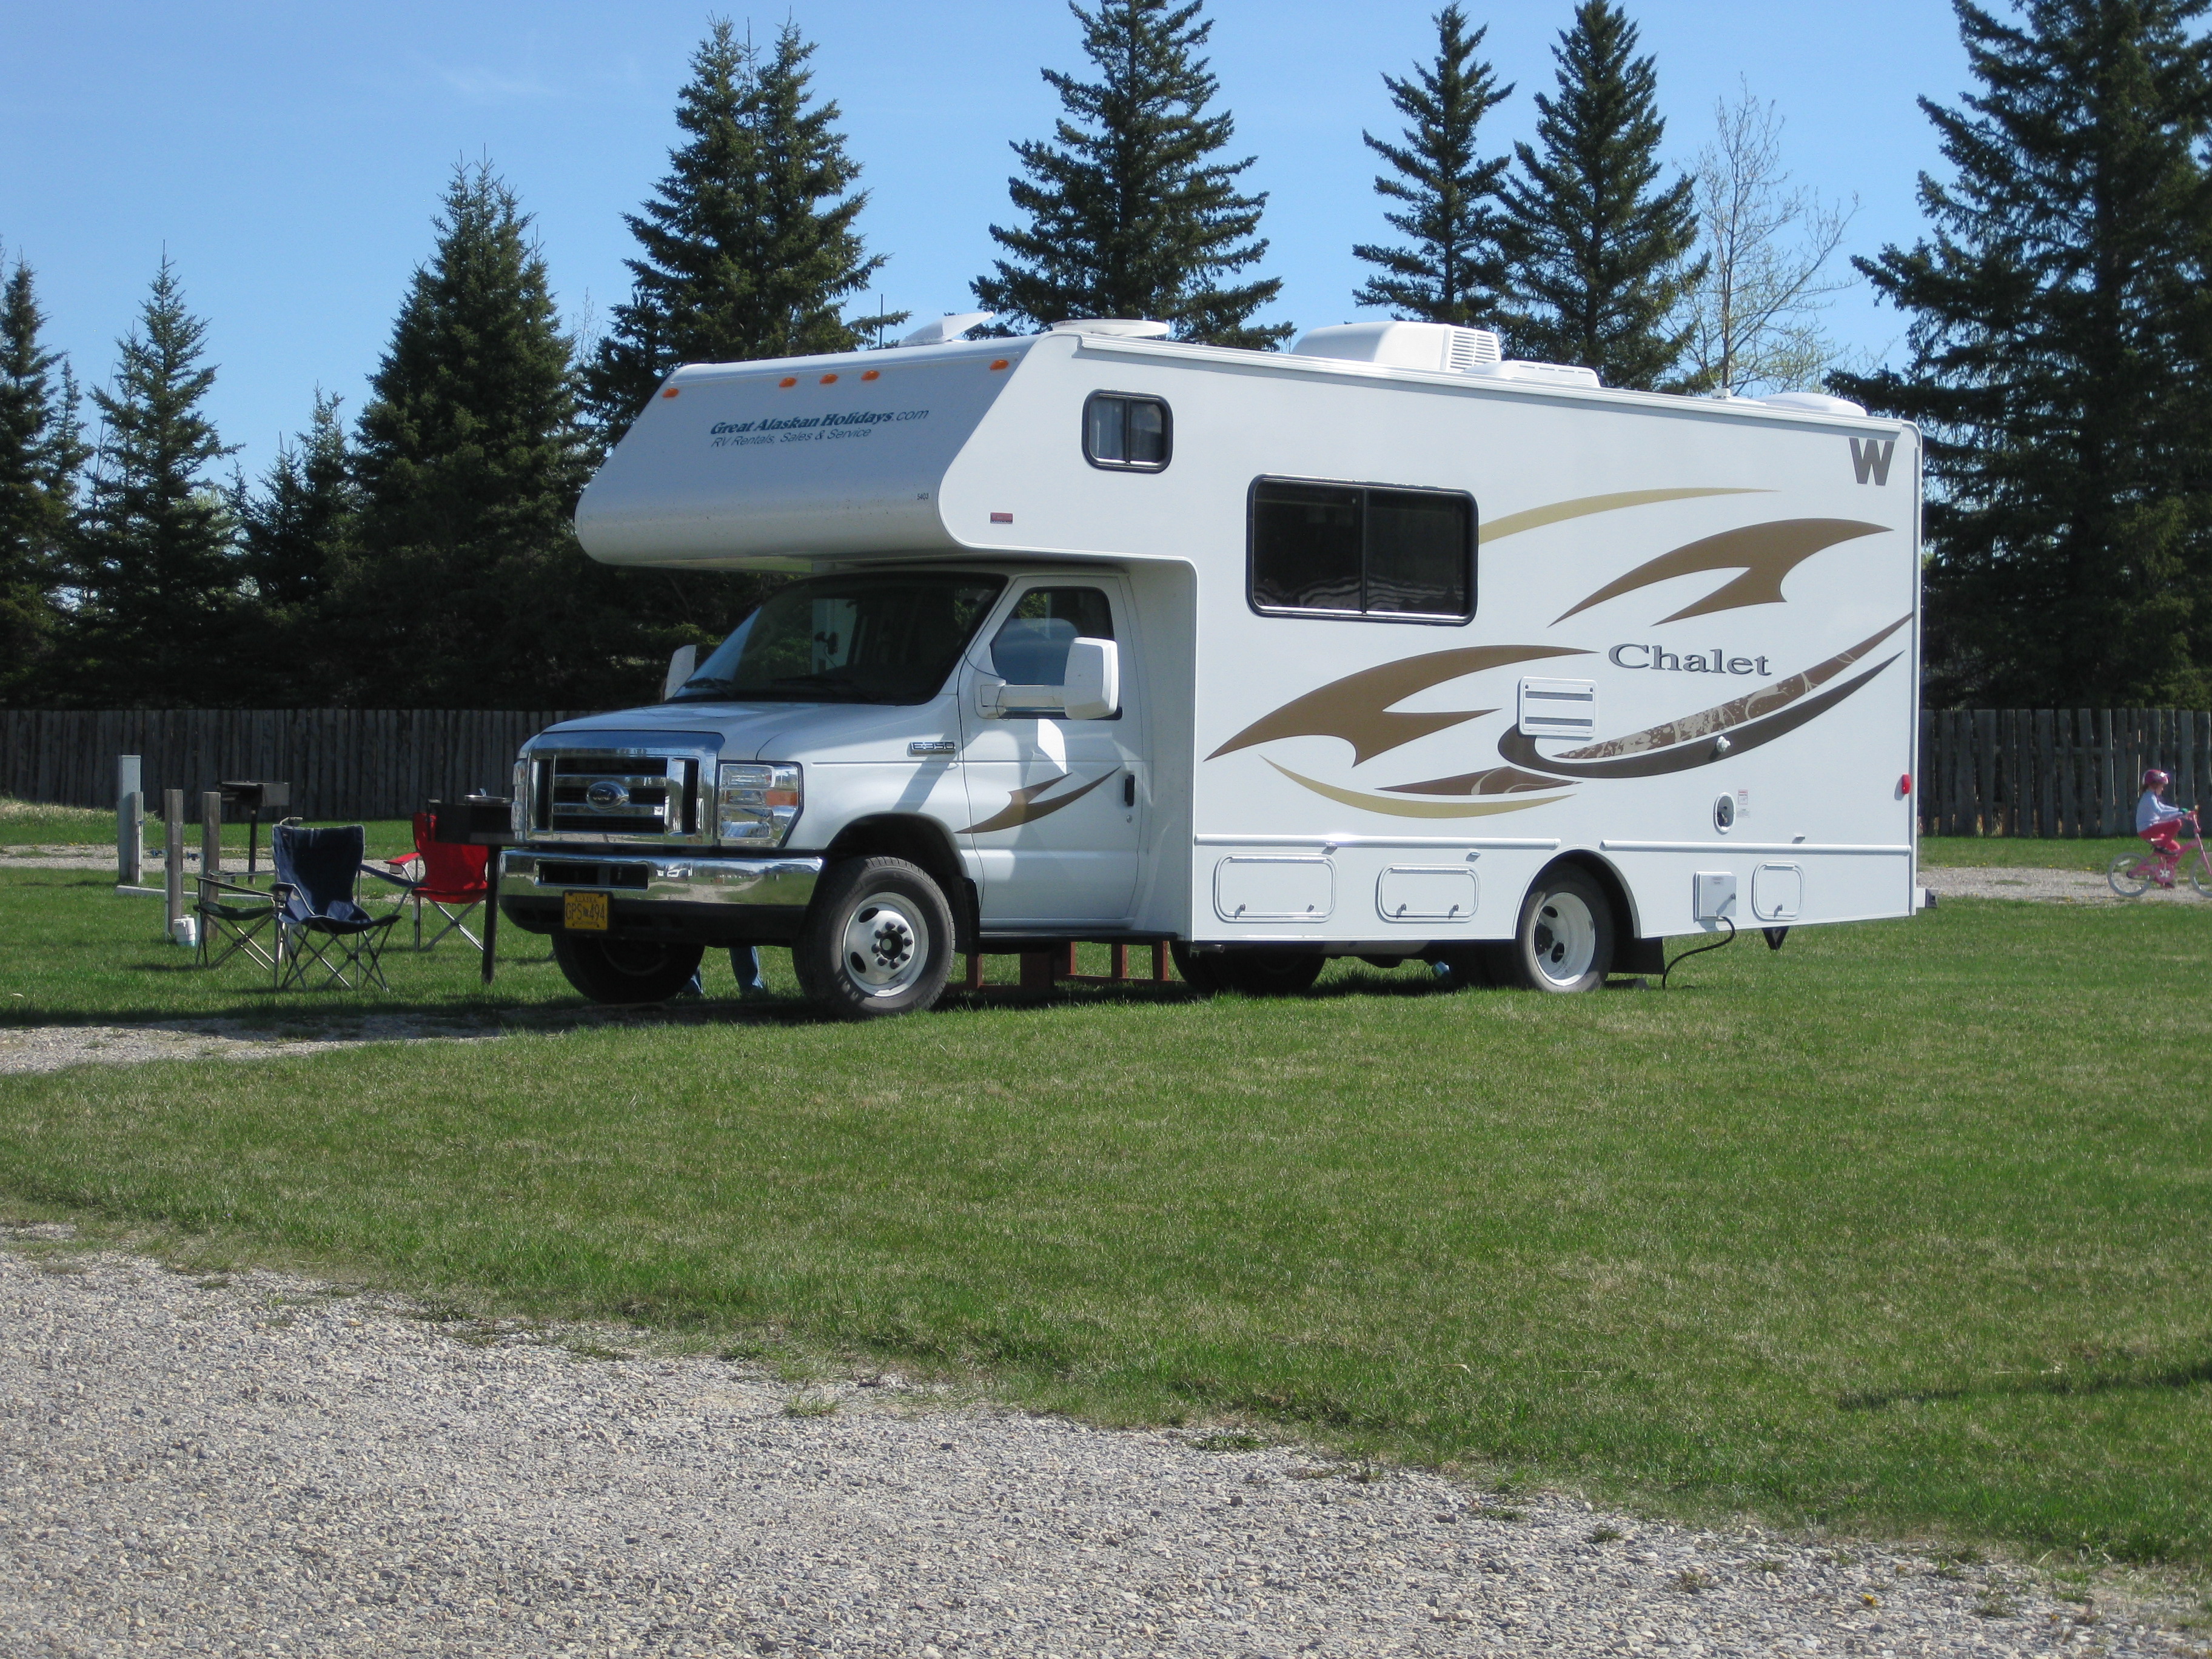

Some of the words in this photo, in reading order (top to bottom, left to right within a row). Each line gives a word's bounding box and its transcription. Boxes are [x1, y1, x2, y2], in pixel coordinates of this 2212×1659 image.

[711, 420, 755, 435] Great
[754, 417, 820, 432] Alaskan
[820, 410, 930, 426] Holidays.com
[711, 437, 732, 447] RV
[731, 434, 775, 446] Rentals,
[780, 432, 813, 443] Sales
[814, 429, 826, 440] &
[827, 427, 872, 440] Service
[1848, 437, 1895, 486] W
[1608, 643, 1772, 676] Chalet
[589, 903, 605, 921] 494
